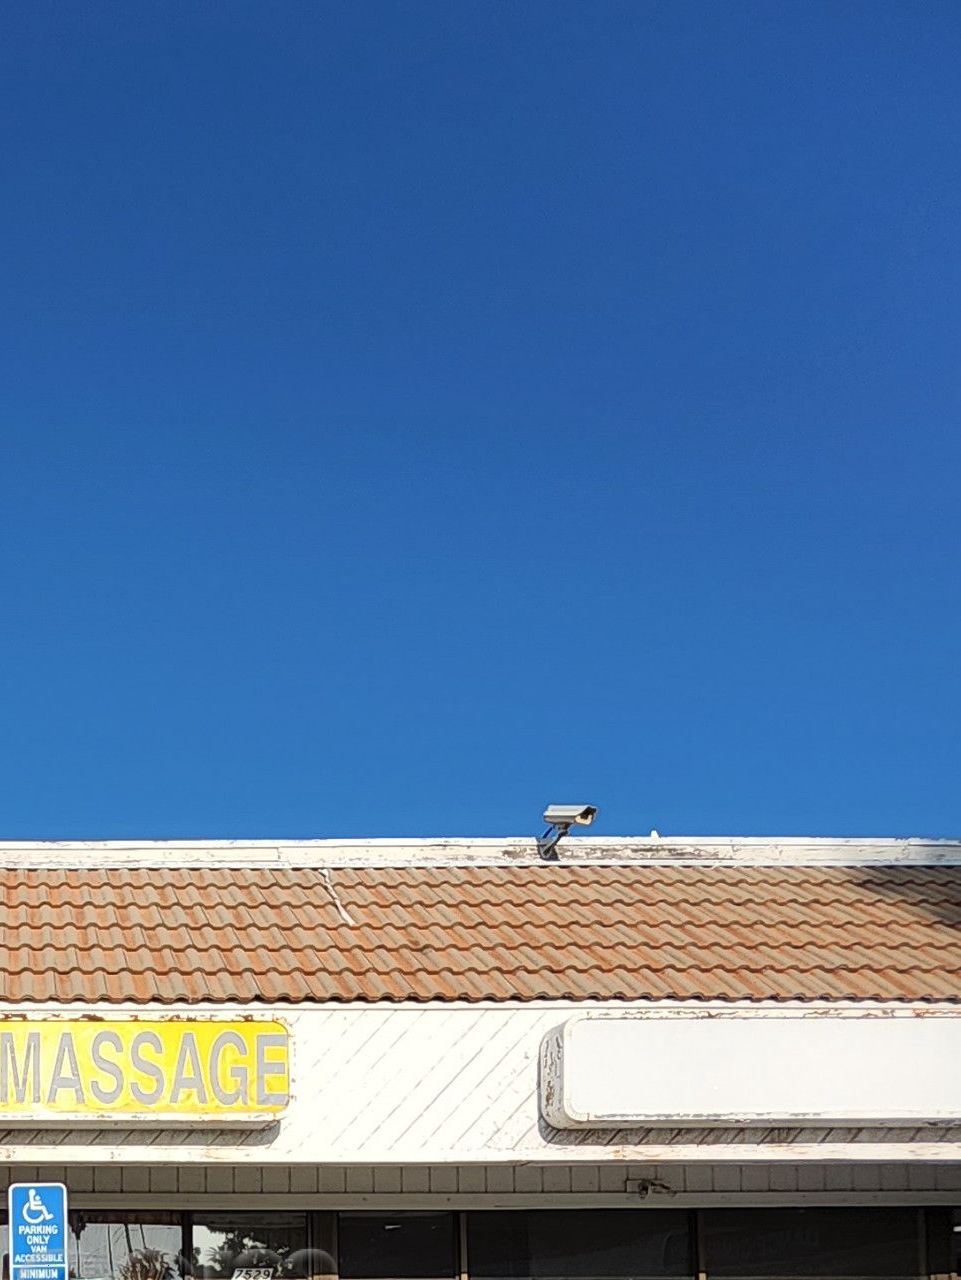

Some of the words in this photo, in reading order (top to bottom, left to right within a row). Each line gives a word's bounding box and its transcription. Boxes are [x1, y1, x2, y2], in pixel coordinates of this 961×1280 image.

[0, 1030, 288, 1106] MASSAGE
[19, 1225, 58, 1235] PARKING
[27, 1235, 50, 1246] ONLY
[30, 1245, 47, 1253] VAN
[15, 1253, 63, 1263] ACCESSIBLE
[19, 1269, 58, 1279] MINIMUM
[235, 1269, 270, 1280] 7529
